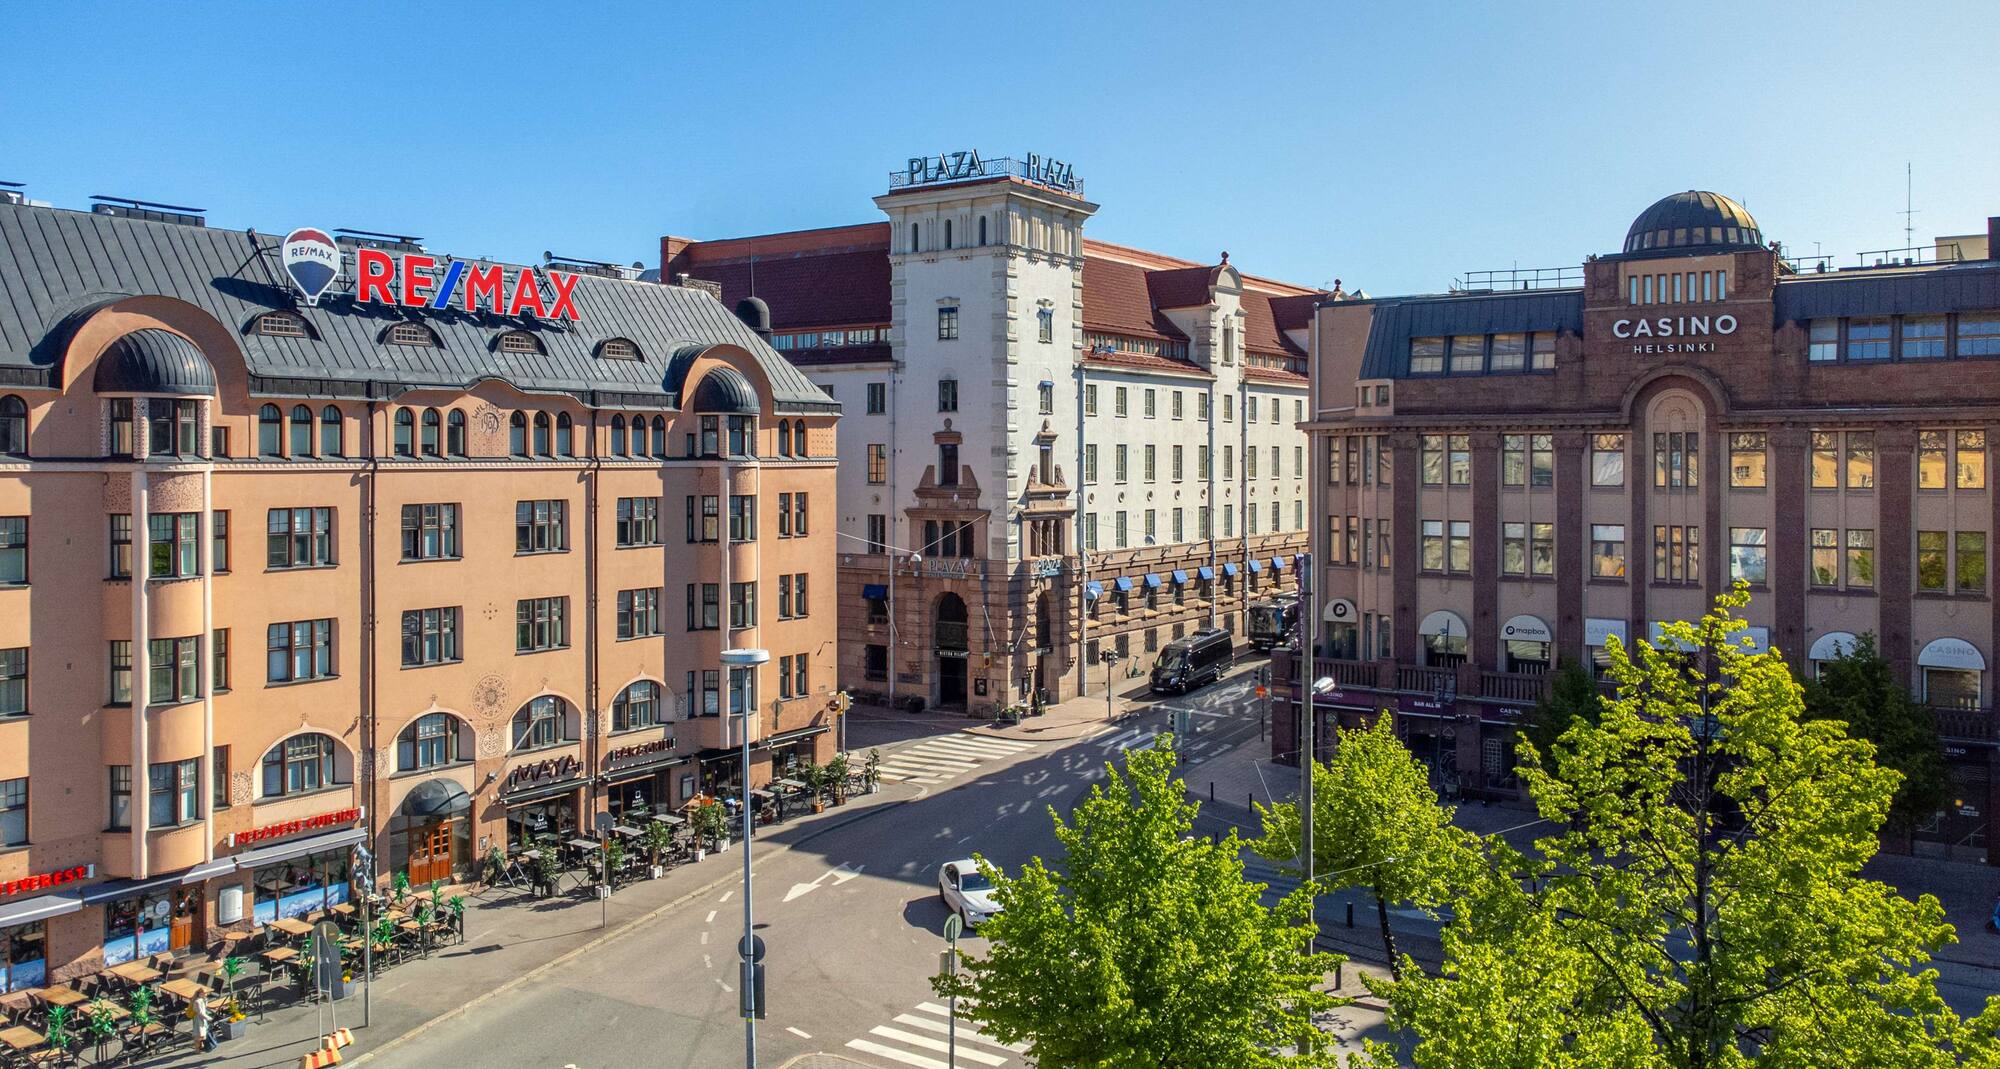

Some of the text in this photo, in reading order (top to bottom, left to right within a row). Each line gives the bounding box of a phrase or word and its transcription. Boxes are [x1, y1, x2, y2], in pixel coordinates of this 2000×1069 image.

[908, 148, 984, 185] PLAZA
[1027, 152, 1076, 190] PLAZA
[291, 246, 333, 262] RE/MAX
[356, 248, 582, 322] RE/MAX
[1613, 314, 1738, 338] CASINO
[1634, 343, 1715, 354] HELSINKI
[928, 559, 966, 573] PLAZA
[1515, 627, 1546, 636] mapbox
[1928, 646, 1976, 656] CASINO
[515, 754, 579, 782] MAYA
[6, 864, 87, 896] EVEREST
